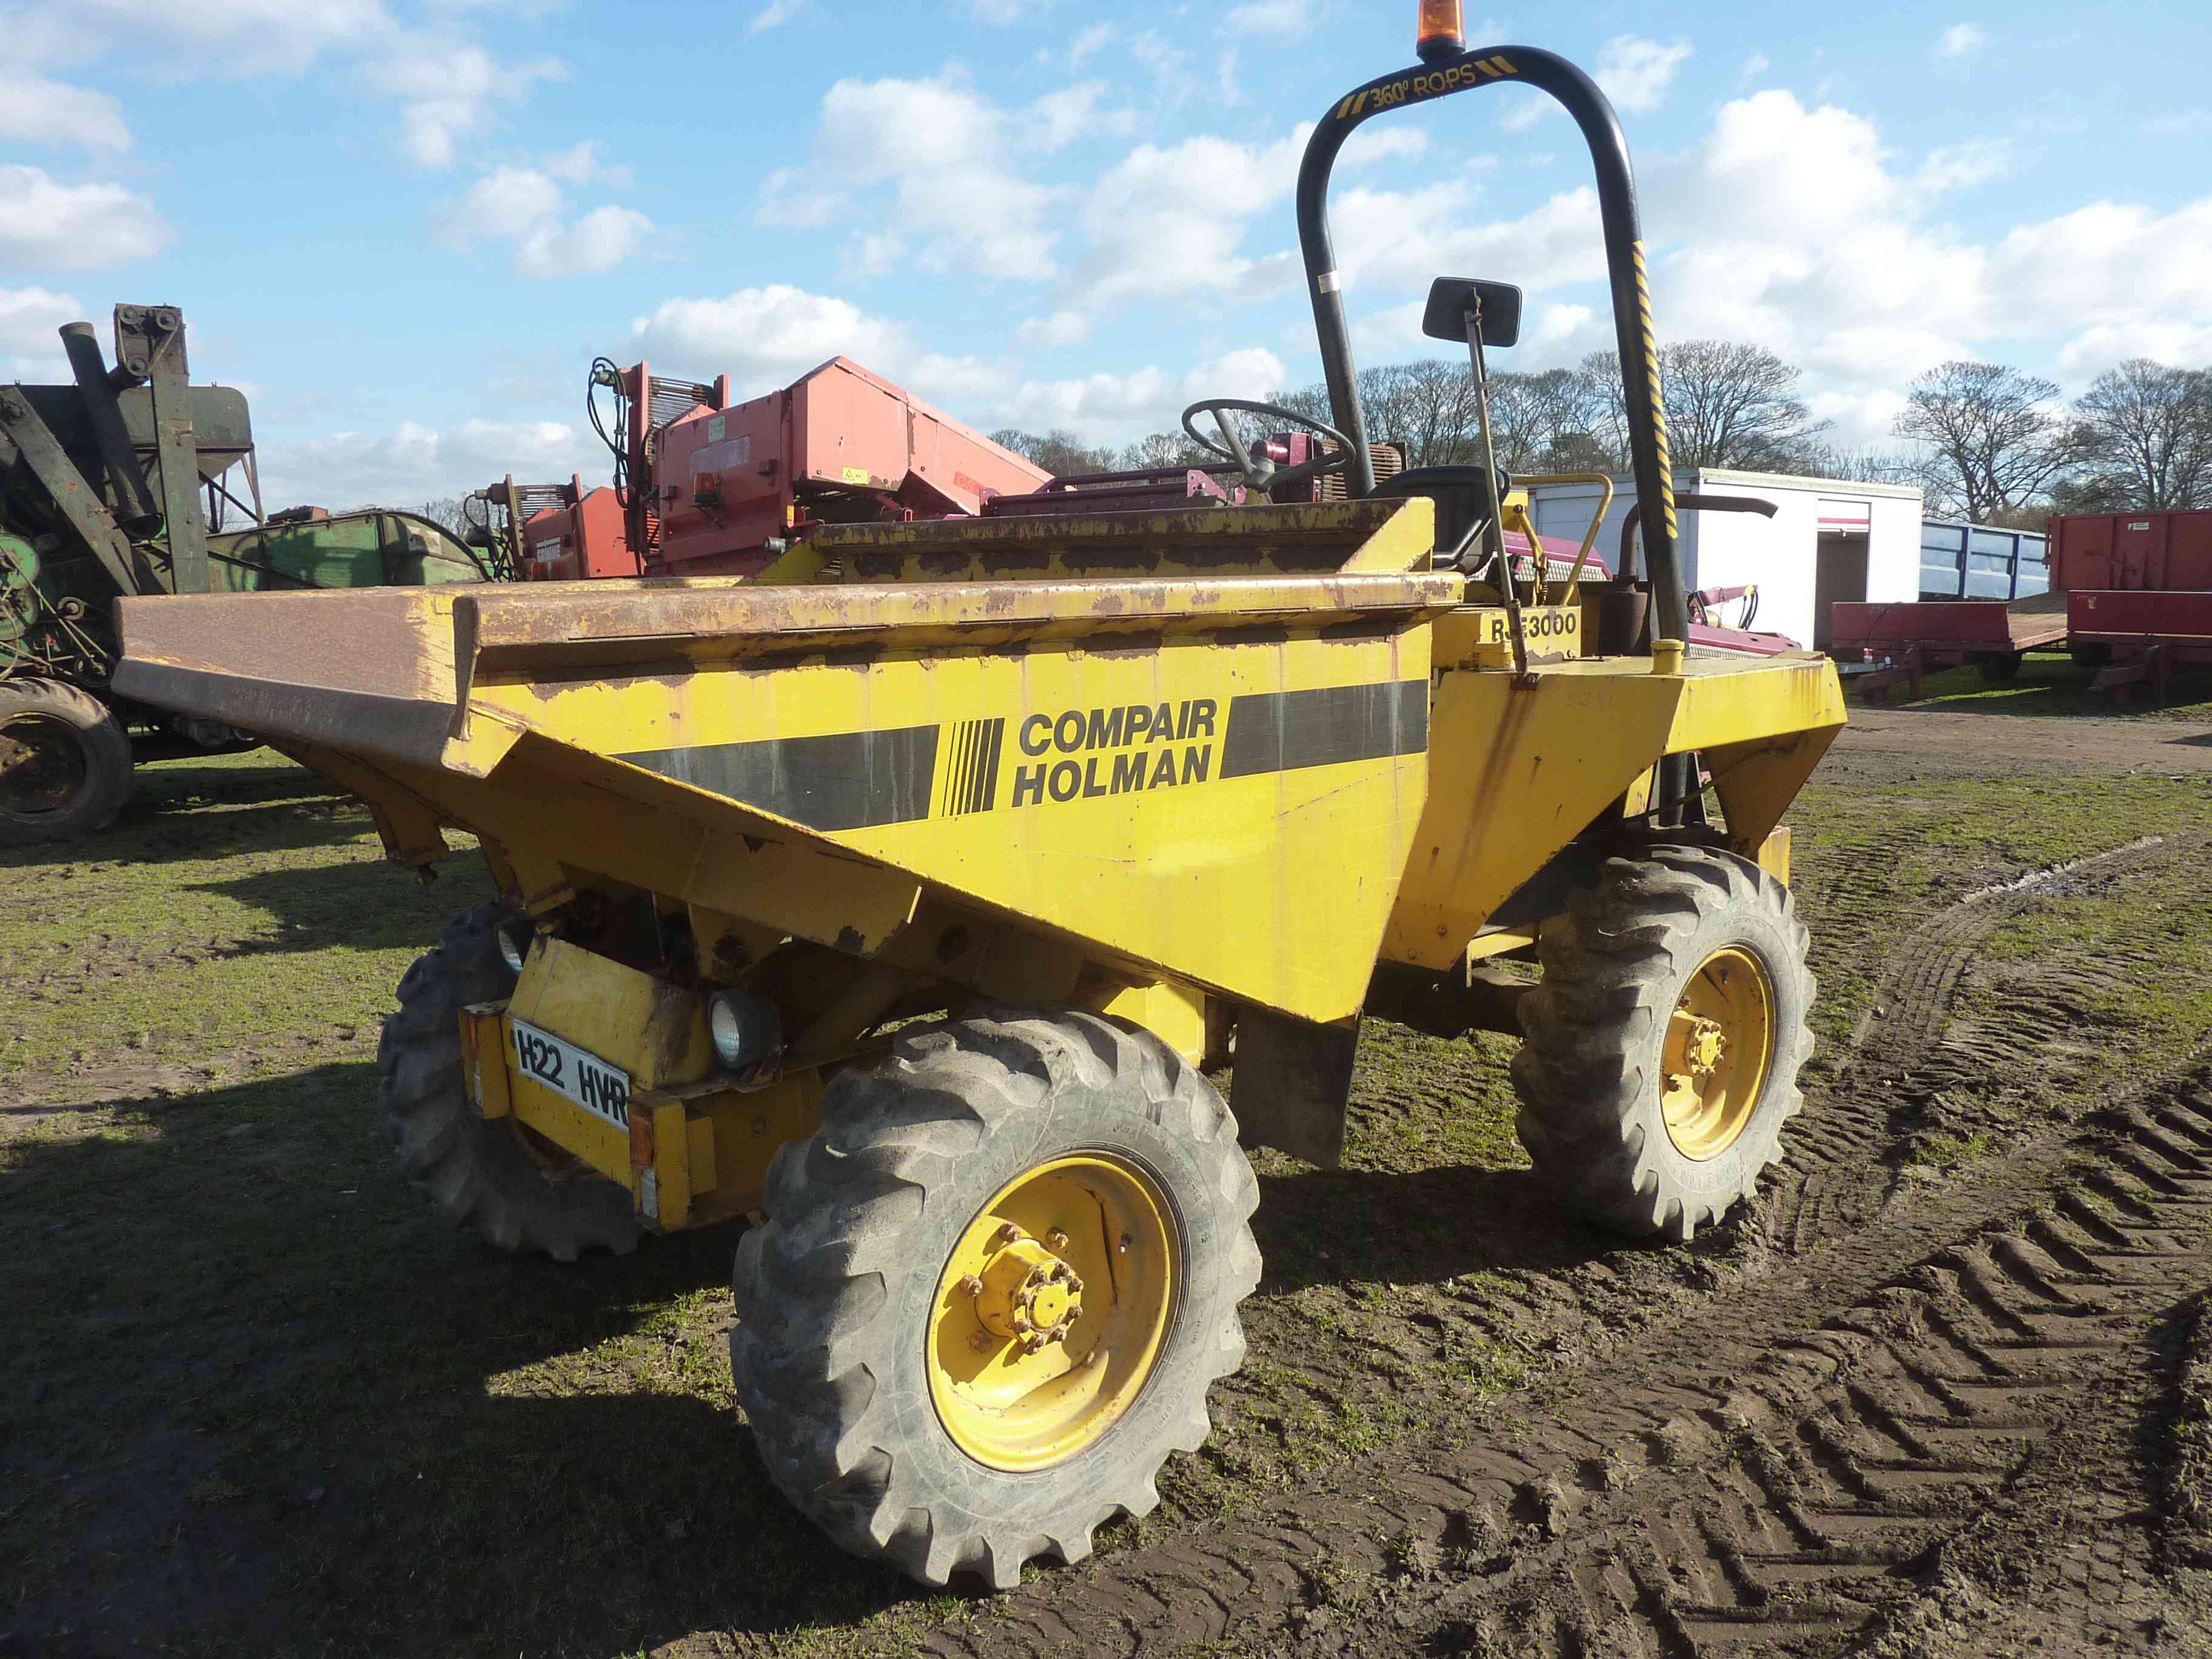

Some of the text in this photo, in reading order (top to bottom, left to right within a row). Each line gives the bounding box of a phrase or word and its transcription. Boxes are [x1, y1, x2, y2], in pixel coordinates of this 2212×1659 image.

[1413, 63, 1476, 97] ROPS
[1019, 698, 1218, 757] COMPAIR
[1011, 743, 1212, 808] HOLMAN
[517, 1029, 629, 1127] H22 HVR
